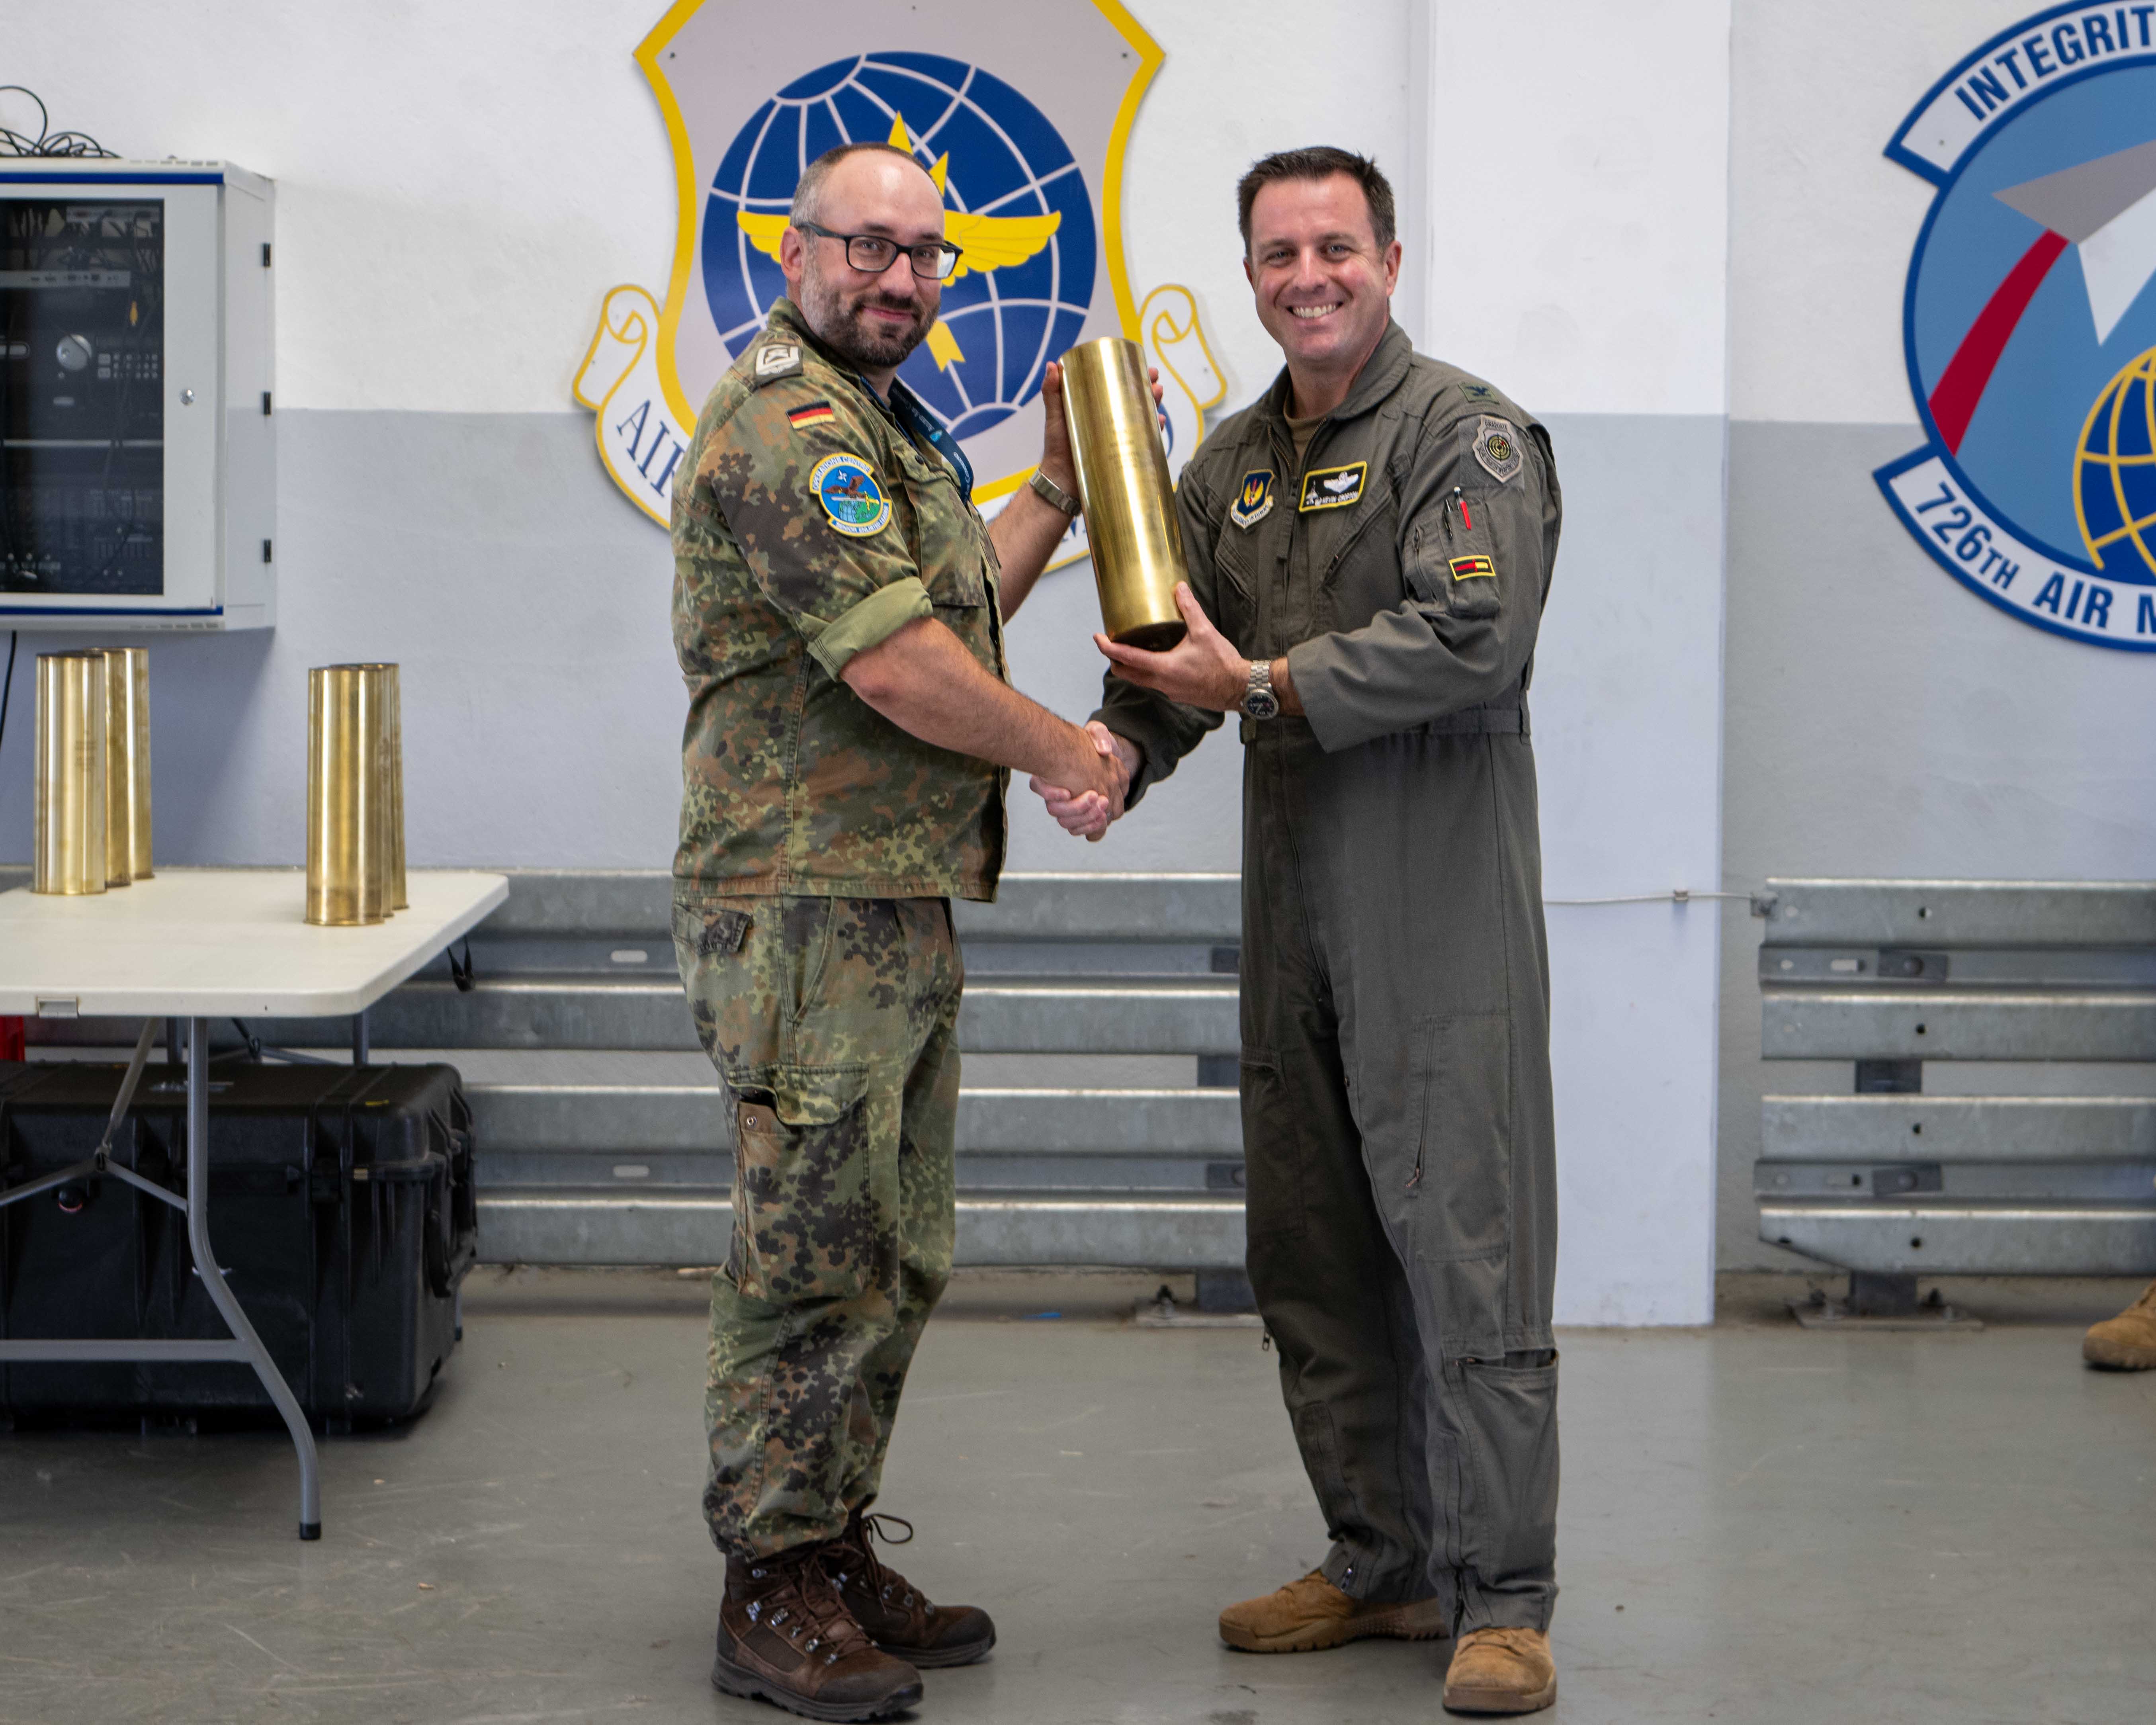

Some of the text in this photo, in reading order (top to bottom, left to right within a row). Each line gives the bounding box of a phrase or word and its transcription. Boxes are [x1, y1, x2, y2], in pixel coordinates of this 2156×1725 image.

[1953, 5, 2155, 122] INTEGRIT
[1484, 420, 1507, 430] GRADUATE
[1915, 481, 2020, 590] 726TH
[2032, 571, 2113, 629] AIR
